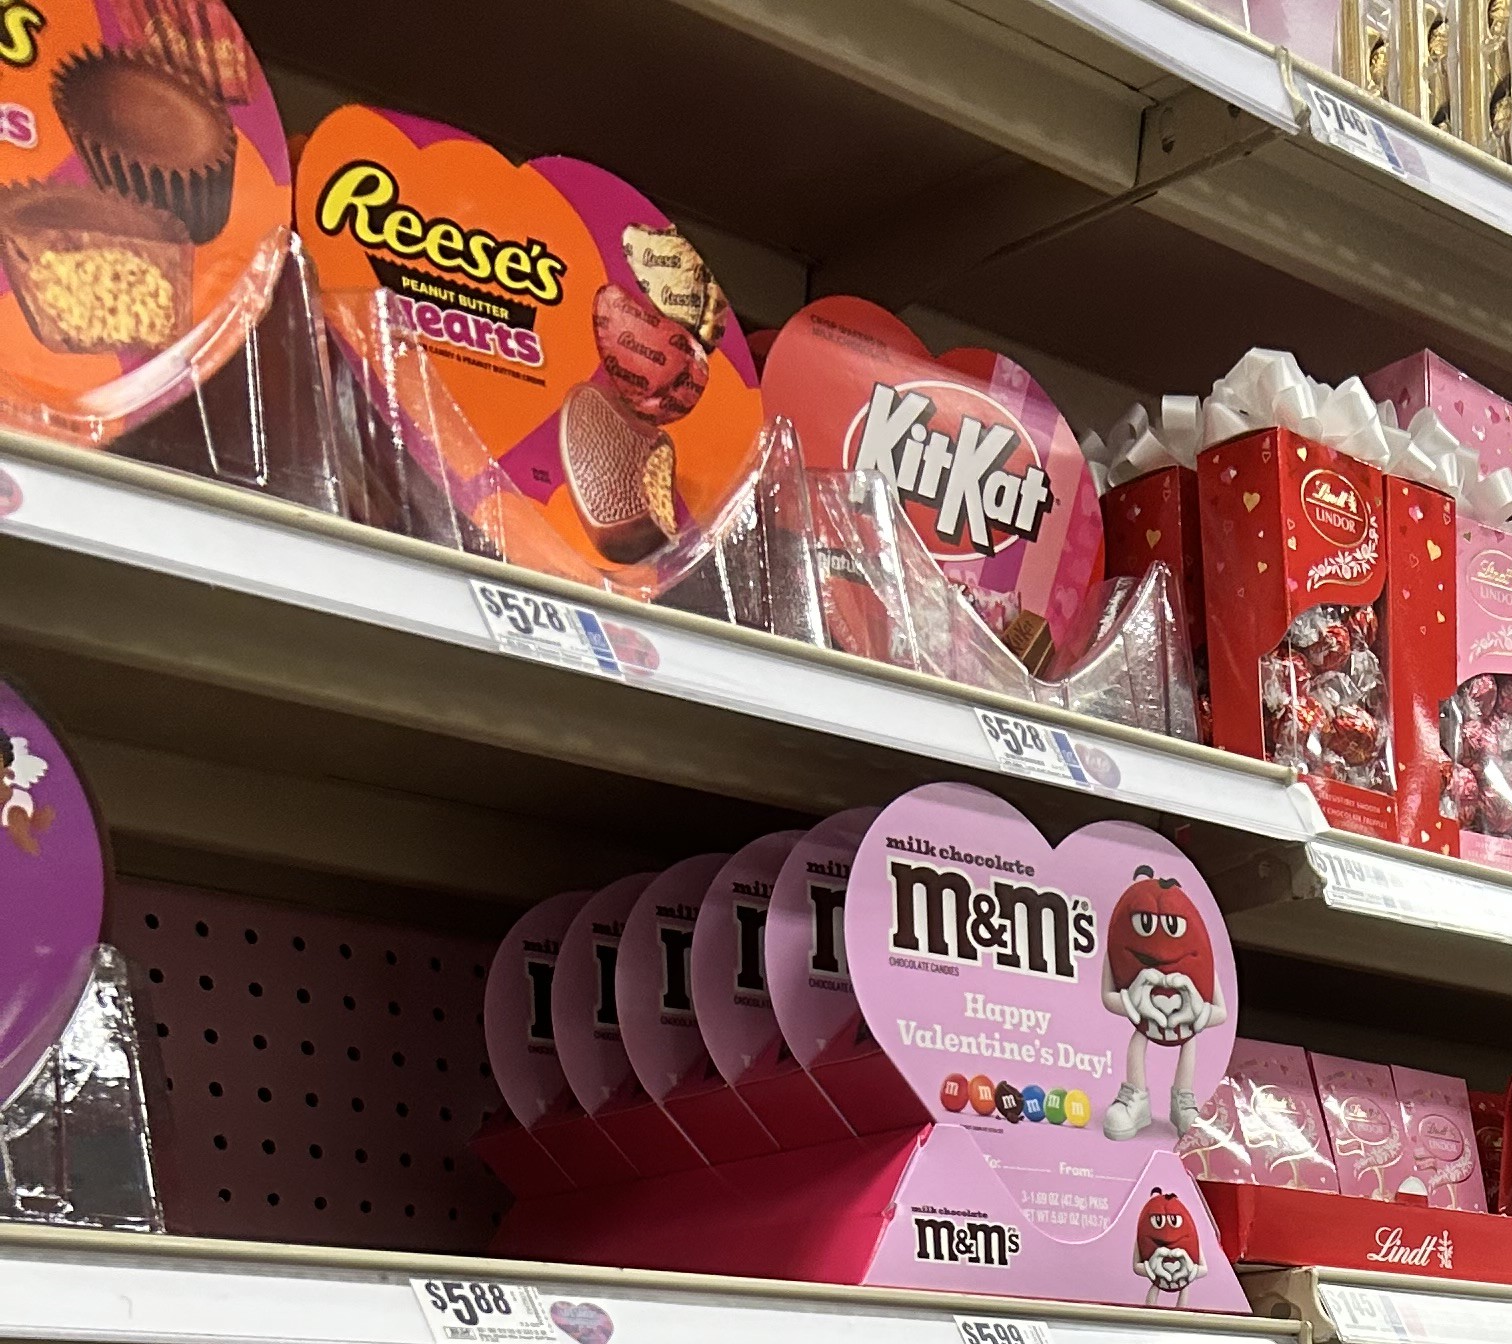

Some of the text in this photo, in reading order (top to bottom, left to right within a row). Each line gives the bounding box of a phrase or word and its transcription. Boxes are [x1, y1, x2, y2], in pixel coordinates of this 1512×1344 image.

[321, 165, 562, 300] Reese's
[401, 276, 510, 320] PEANUT BUTTER
[886, 834, 1036, 878] milk chocolate
[964, 992, 1052, 1035] Happy
[897, 1018, 1113, 1078] Valentine's Day!
[1367, 1227, 1436, 1267] Lindt
